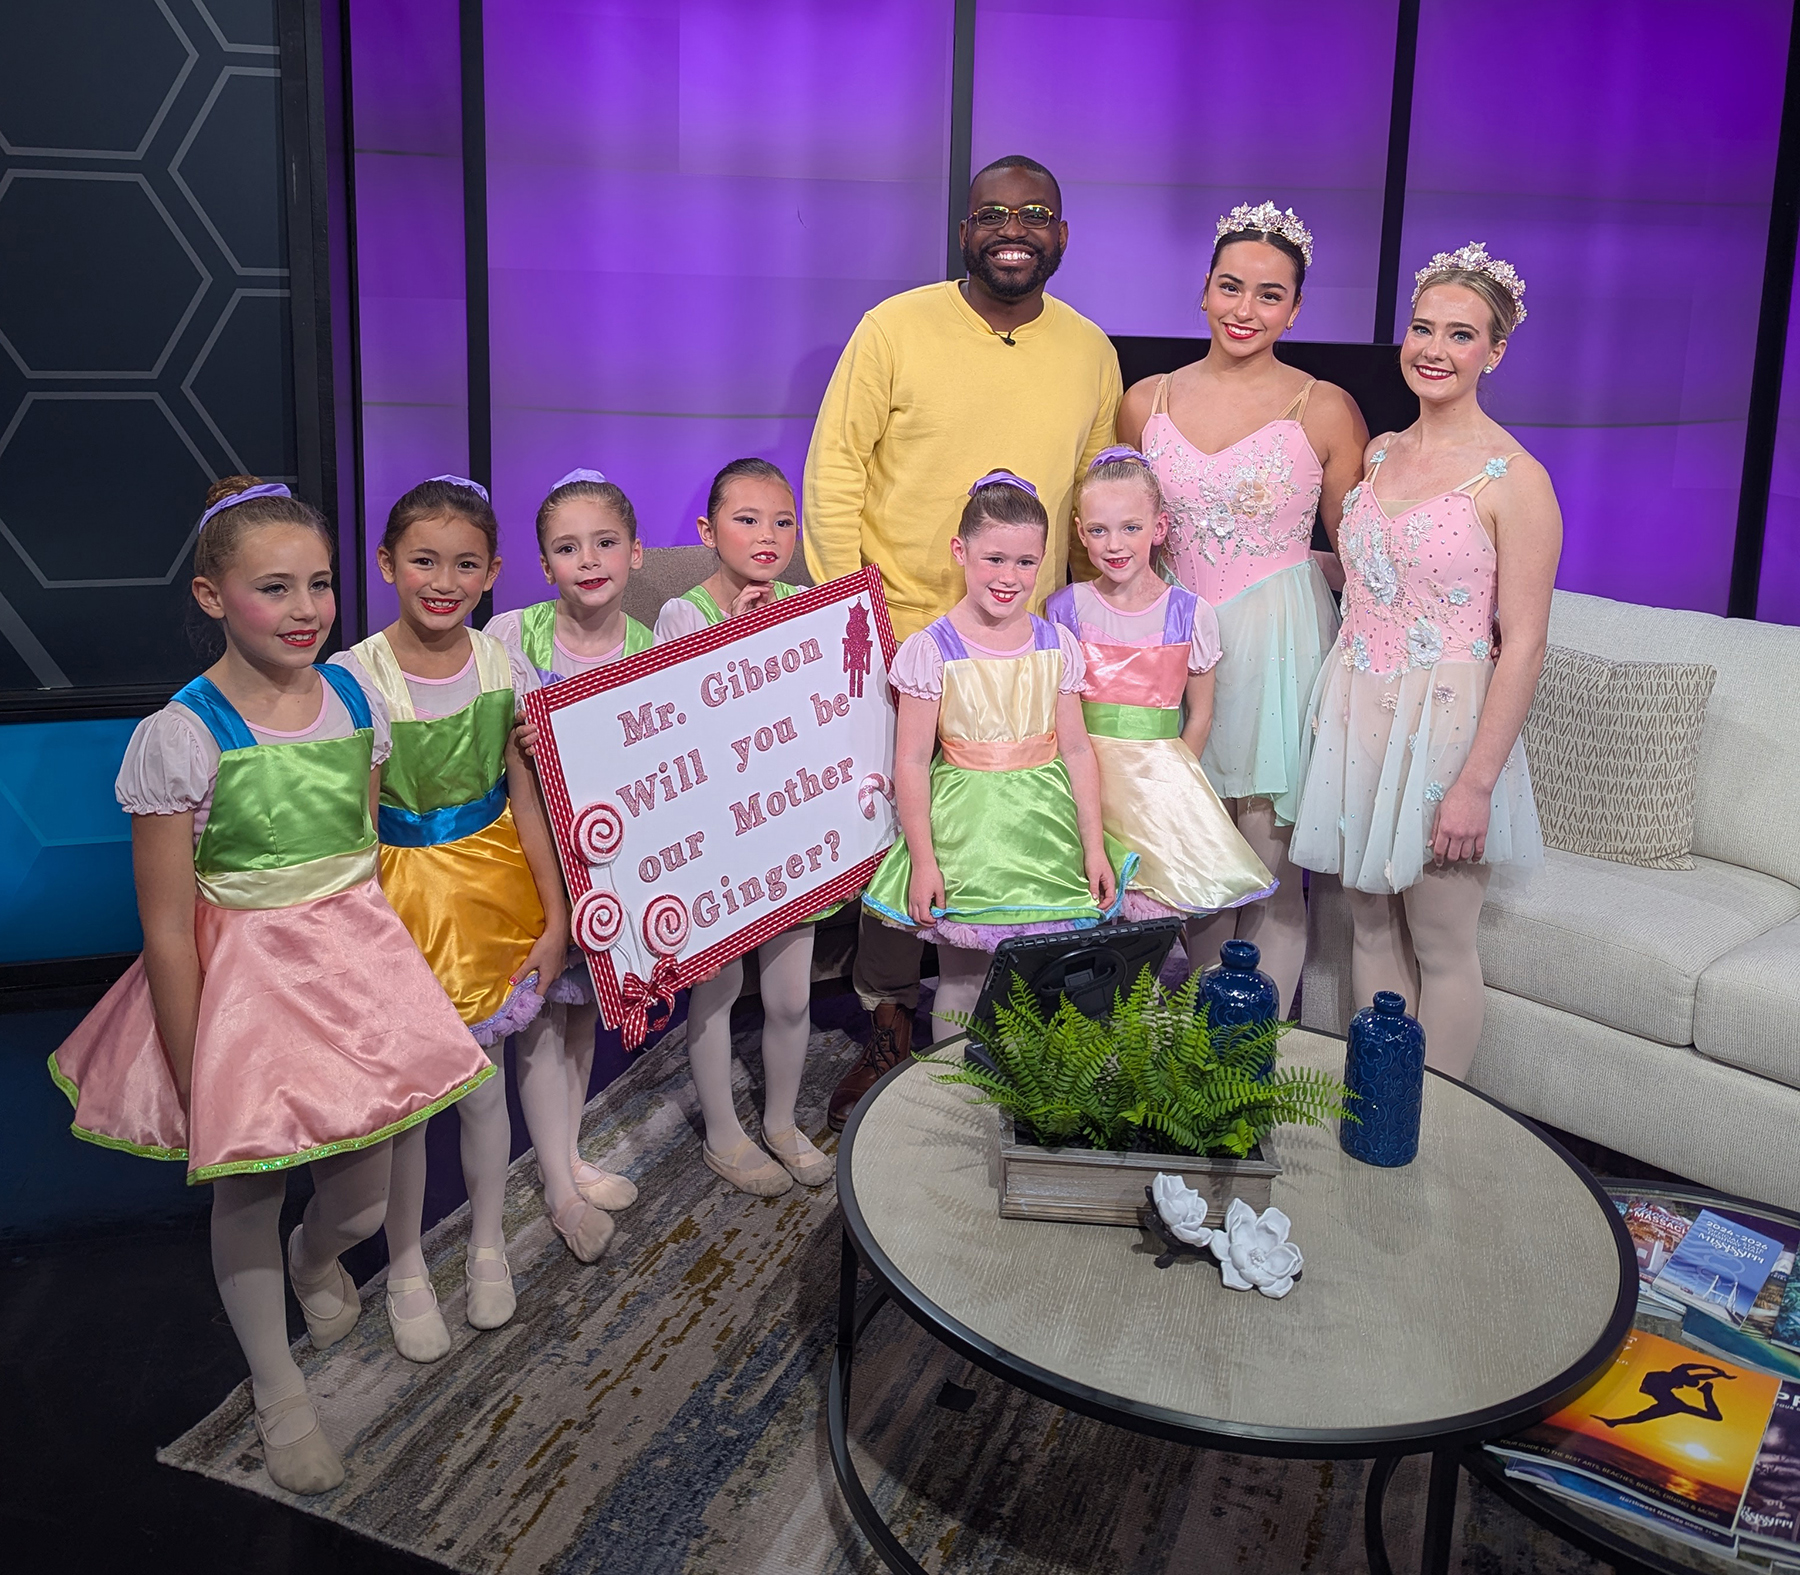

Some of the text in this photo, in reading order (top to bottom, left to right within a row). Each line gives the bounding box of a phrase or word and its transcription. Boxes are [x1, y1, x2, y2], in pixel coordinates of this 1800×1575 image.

[616, 637, 823, 747] Mr. Gibson
[616, 692, 850, 818] Will you be
[638, 757, 853, 883] our Mother
[692, 829, 840, 929] Ginger?
[1698, 1232, 1766, 1264] MISSISSIPPI
[1518, 1442, 1539, 1451] GUIDE
[1551, 1449, 1563, 1457] THE
[1564, 1453, 1581, 1462] BEST
[1697, 1507, 1719, 1519] MORE
[1740, 1508, 1794, 1529] ISSISSIPPI
